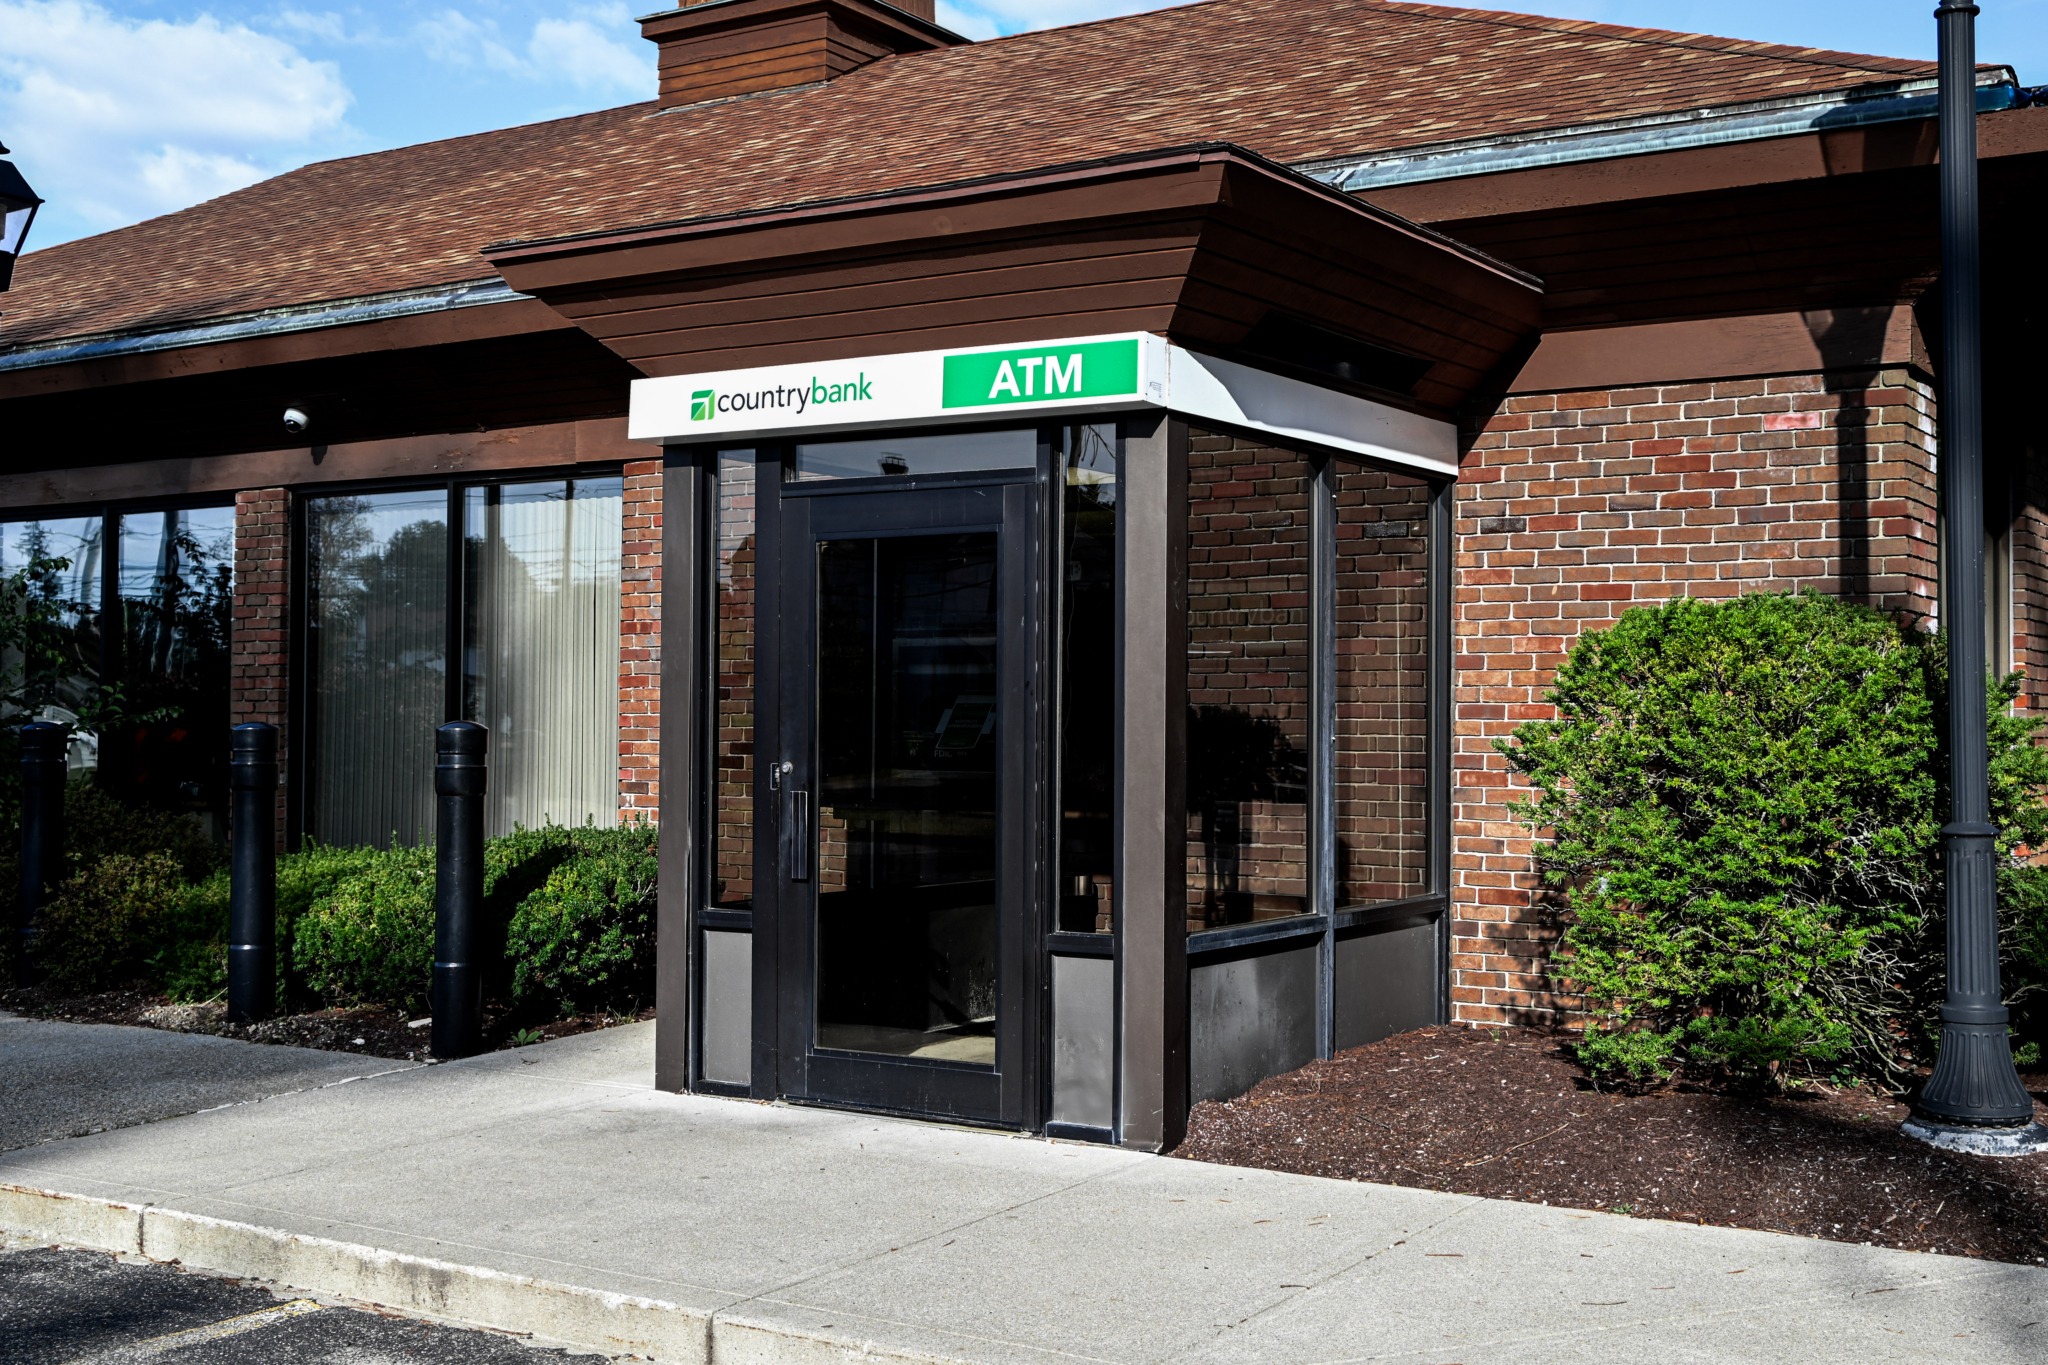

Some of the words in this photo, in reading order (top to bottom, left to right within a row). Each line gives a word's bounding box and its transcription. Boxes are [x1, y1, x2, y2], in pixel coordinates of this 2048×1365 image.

[717, 371, 873, 415] countrybank
[989, 353, 1082, 399] ATM
[1188, 599, 1303, 632] ountryban
